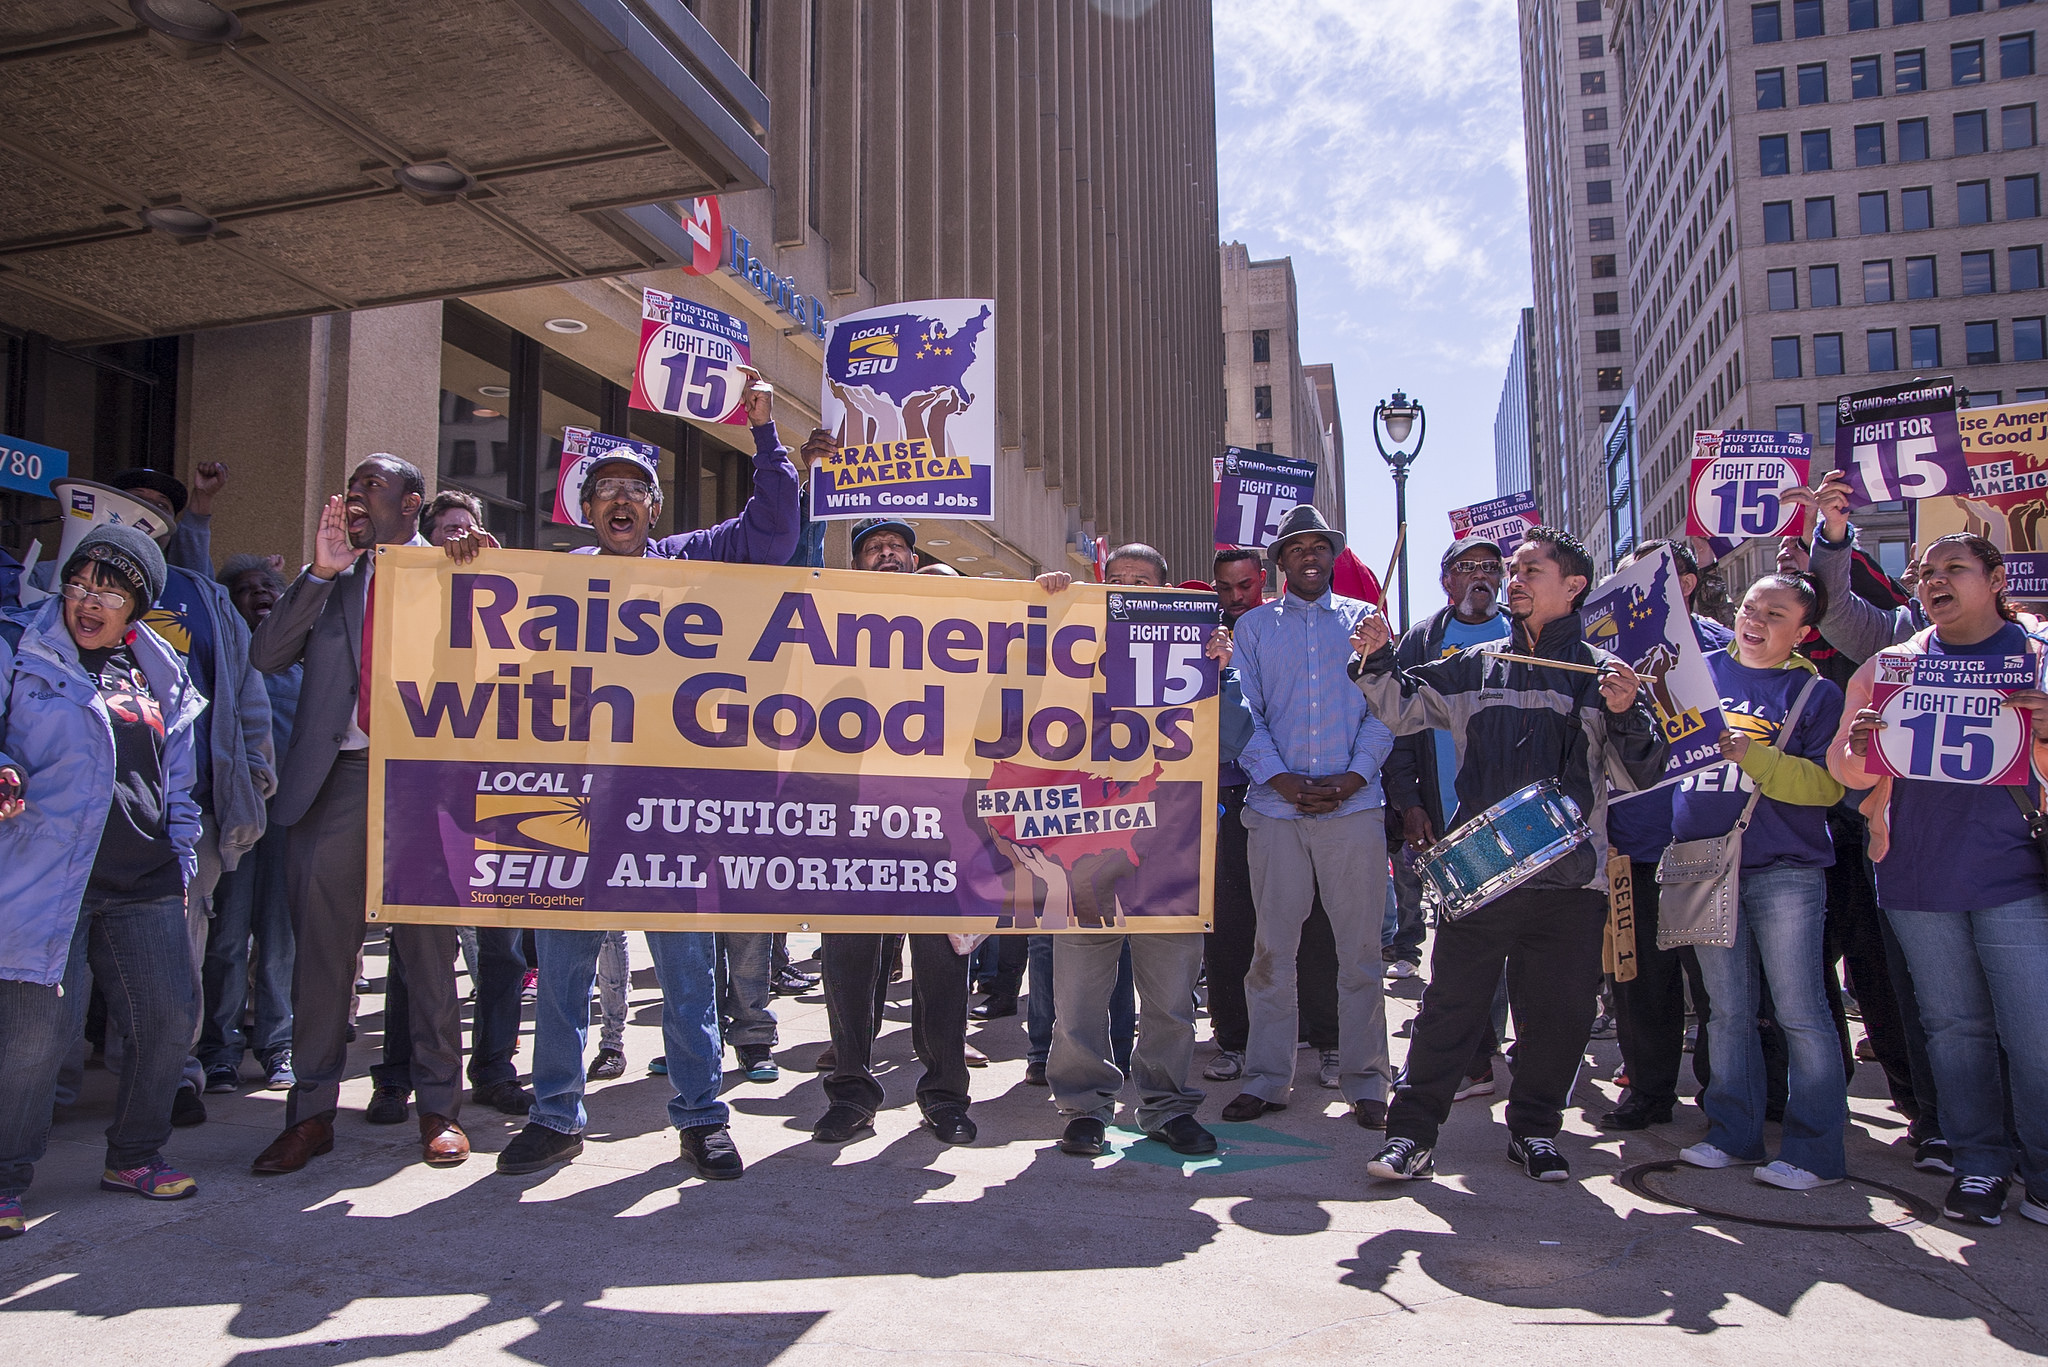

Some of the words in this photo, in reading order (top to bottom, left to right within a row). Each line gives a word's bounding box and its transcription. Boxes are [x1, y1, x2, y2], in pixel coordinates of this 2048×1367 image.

[729, 224, 805, 325] Harris
[675, 301, 719, 321] JUSTICE
[674, 312, 694, 325] FOR
[700, 318, 749, 342] JANITORS
[851, 326, 890, 341] LOCAL
[894, 325, 900, 335] 1
[664, 330, 704, 354] FIGHT
[708, 340, 732, 361] FOR
[845, 358, 898, 378] SEIU
[661, 352, 728, 419] 15
[1852, 396, 1882, 412] STAND
[1883, 398, 1897, 406] FOR
[1898, 385, 1953, 405] SECURITY
[1853, 422, 1894, 443] FIGHT
[1899, 417, 1934, 438] FOR
[1960, 417, 1987, 431] ise
[1993, 411, 2048, 428] Amer
[1725, 434, 1775, 443] JUSTICE
[1978, 427, 2032, 446] Good
[829, 441, 927, 465] #RAISE
[1723, 445, 1744, 454] FOR
[1750, 445, 1810, 456] JANITORS
[837, 458, 965, 486] AMERICA
[1239, 460, 1265, 471] STAND
[1277, 465, 1314, 478] SECURITY
[1713, 463, 1753, 480] FIGHT
[1757, 463, 1785, 479] FOR
[1852, 436, 1948, 502] 15
[1969, 461, 2012, 481] AISE
[1239, 480, 1272, 495] FIGHT
[1275, 484, 1297, 498] FOR
[1973, 472, 2048, 496] AMERIC
[827, 493, 871, 507] With
[878, 492, 928, 506] Good
[934, 493, 978, 507] Jobs
[1471, 500, 1507, 515] JUSTICE
[1711, 480, 1780, 535] 15
[1473, 514, 1489, 523] FOR
[1492, 501, 1535, 517] JANITORS
[1503, 520, 1524, 535] FOR
[111, 557, 144, 589] OBAMA
[2003, 562, 2034, 575] TICE
[2007, 578, 2048, 591] JANIT
[1126, 599, 1158, 611] STAND
[1159, 604, 1173, 612] FOR
[1173, 601, 1218, 612] SECURITY
[450, 573, 723, 660] Raise
[748, 591, 1106, 679] Americ
[1584, 606, 1608, 627] LOCAL
[1129, 625, 1169, 641] FIGHT
[1174, 626, 1201, 641] FOR
[1129, 643, 1203, 706] 15
[1919, 658, 1985, 672] JUSTICE
[1917, 671, 1945, 683] FOR
[1953, 672, 2033, 684] JANITORS
[396, 663, 636, 745] with
[672, 671, 945, 756] Good
[975, 688, 1194, 762] Jobs
[1720, 697, 1766, 718] CAL
[1902, 692, 1958, 713] FIGHT
[1963, 696, 2000, 717] FOR
[1685, 743, 1721, 764] Jobs
[1900, 712, 1994, 781] 15
[477, 772, 569, 794] LOCAL
[581, 773, 594, 794] 1
[978, 786, 1080, 812] #RAISE
[626, 797, 837, 837] JUSTICE
[848, 804, 944, 839] FOR
[1021, 806, 1152, 838] AMERICA
[469, 853, 589, 889] SEIU
[607, 852, 707, 889] ALL
[719, 855, 957, 893] WORKERS
[471, 890, 525, 907] Stronger
[528, 892, 585, 909] Together
